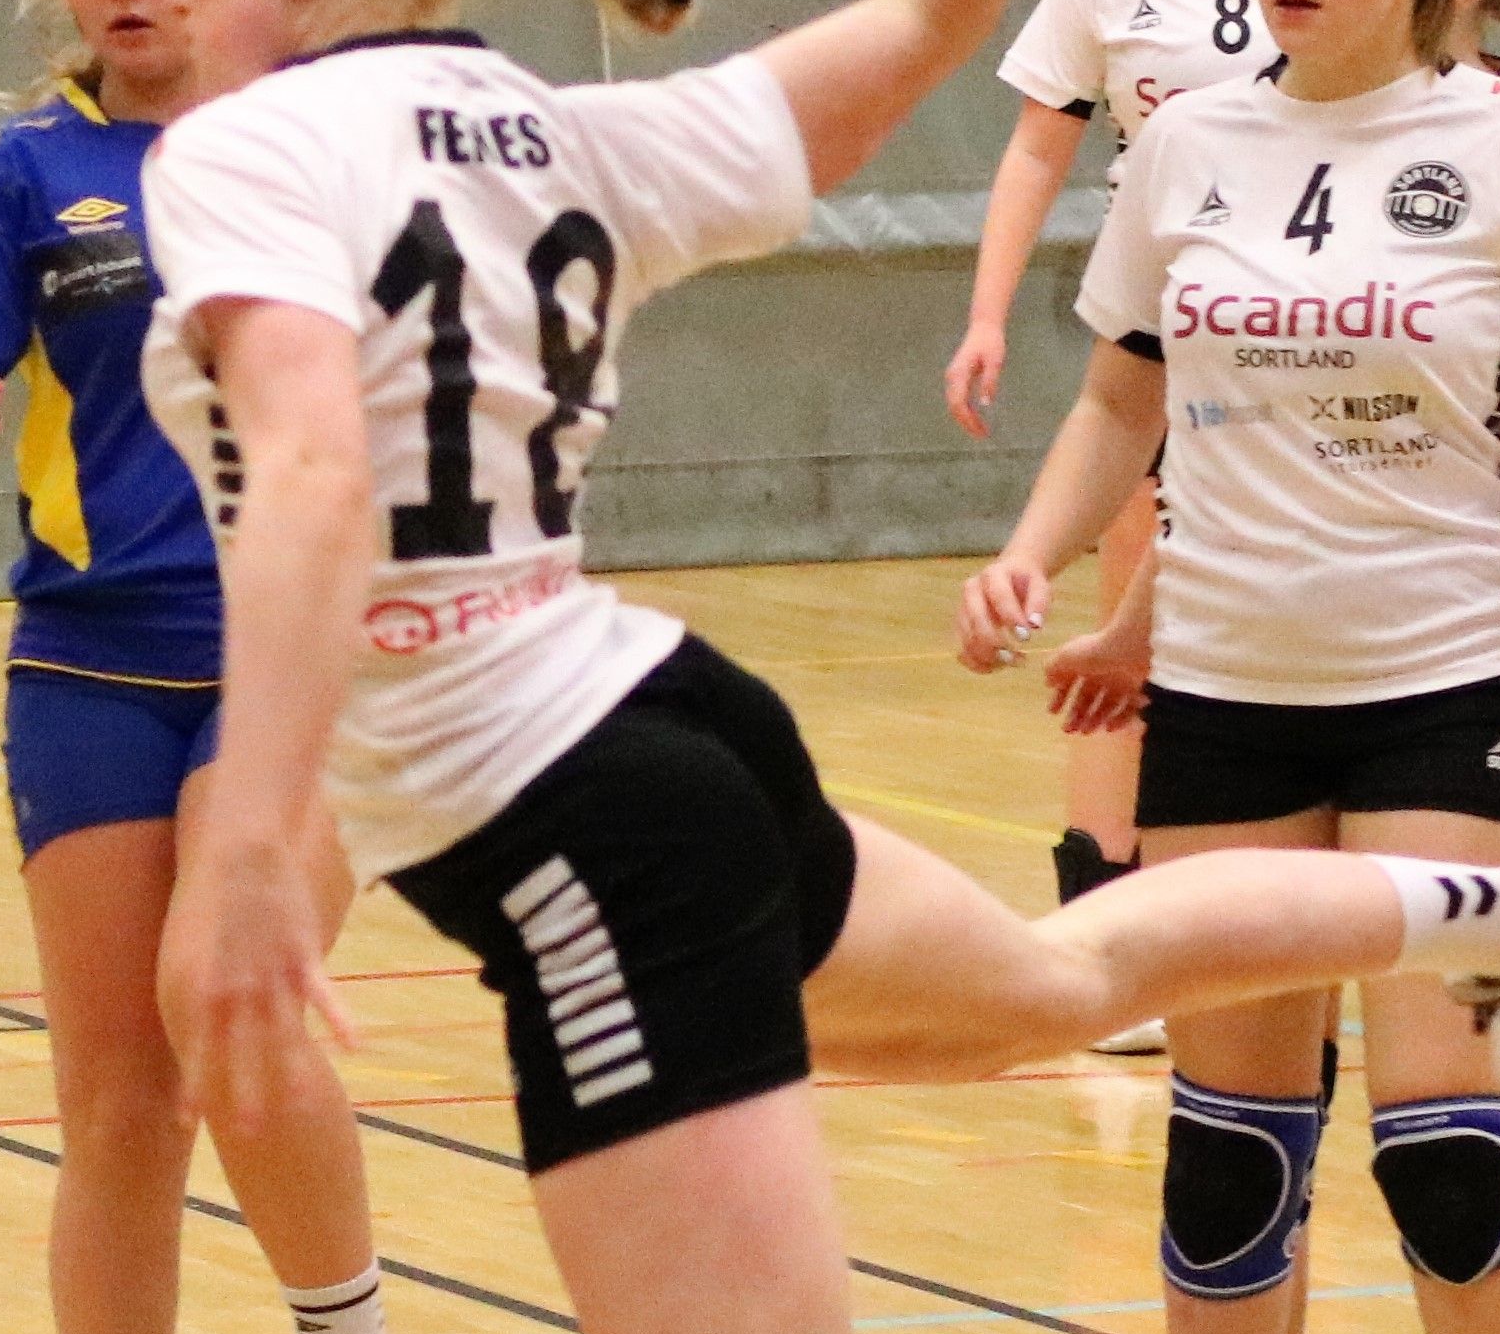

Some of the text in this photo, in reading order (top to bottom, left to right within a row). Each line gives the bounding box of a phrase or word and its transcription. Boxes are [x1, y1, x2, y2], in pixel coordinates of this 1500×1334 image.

[1284, 162, 1334, 256] 4
[1174, 281, 1437, 343] Scandic
[1235, 347, 1356, 369] SORTLAND
